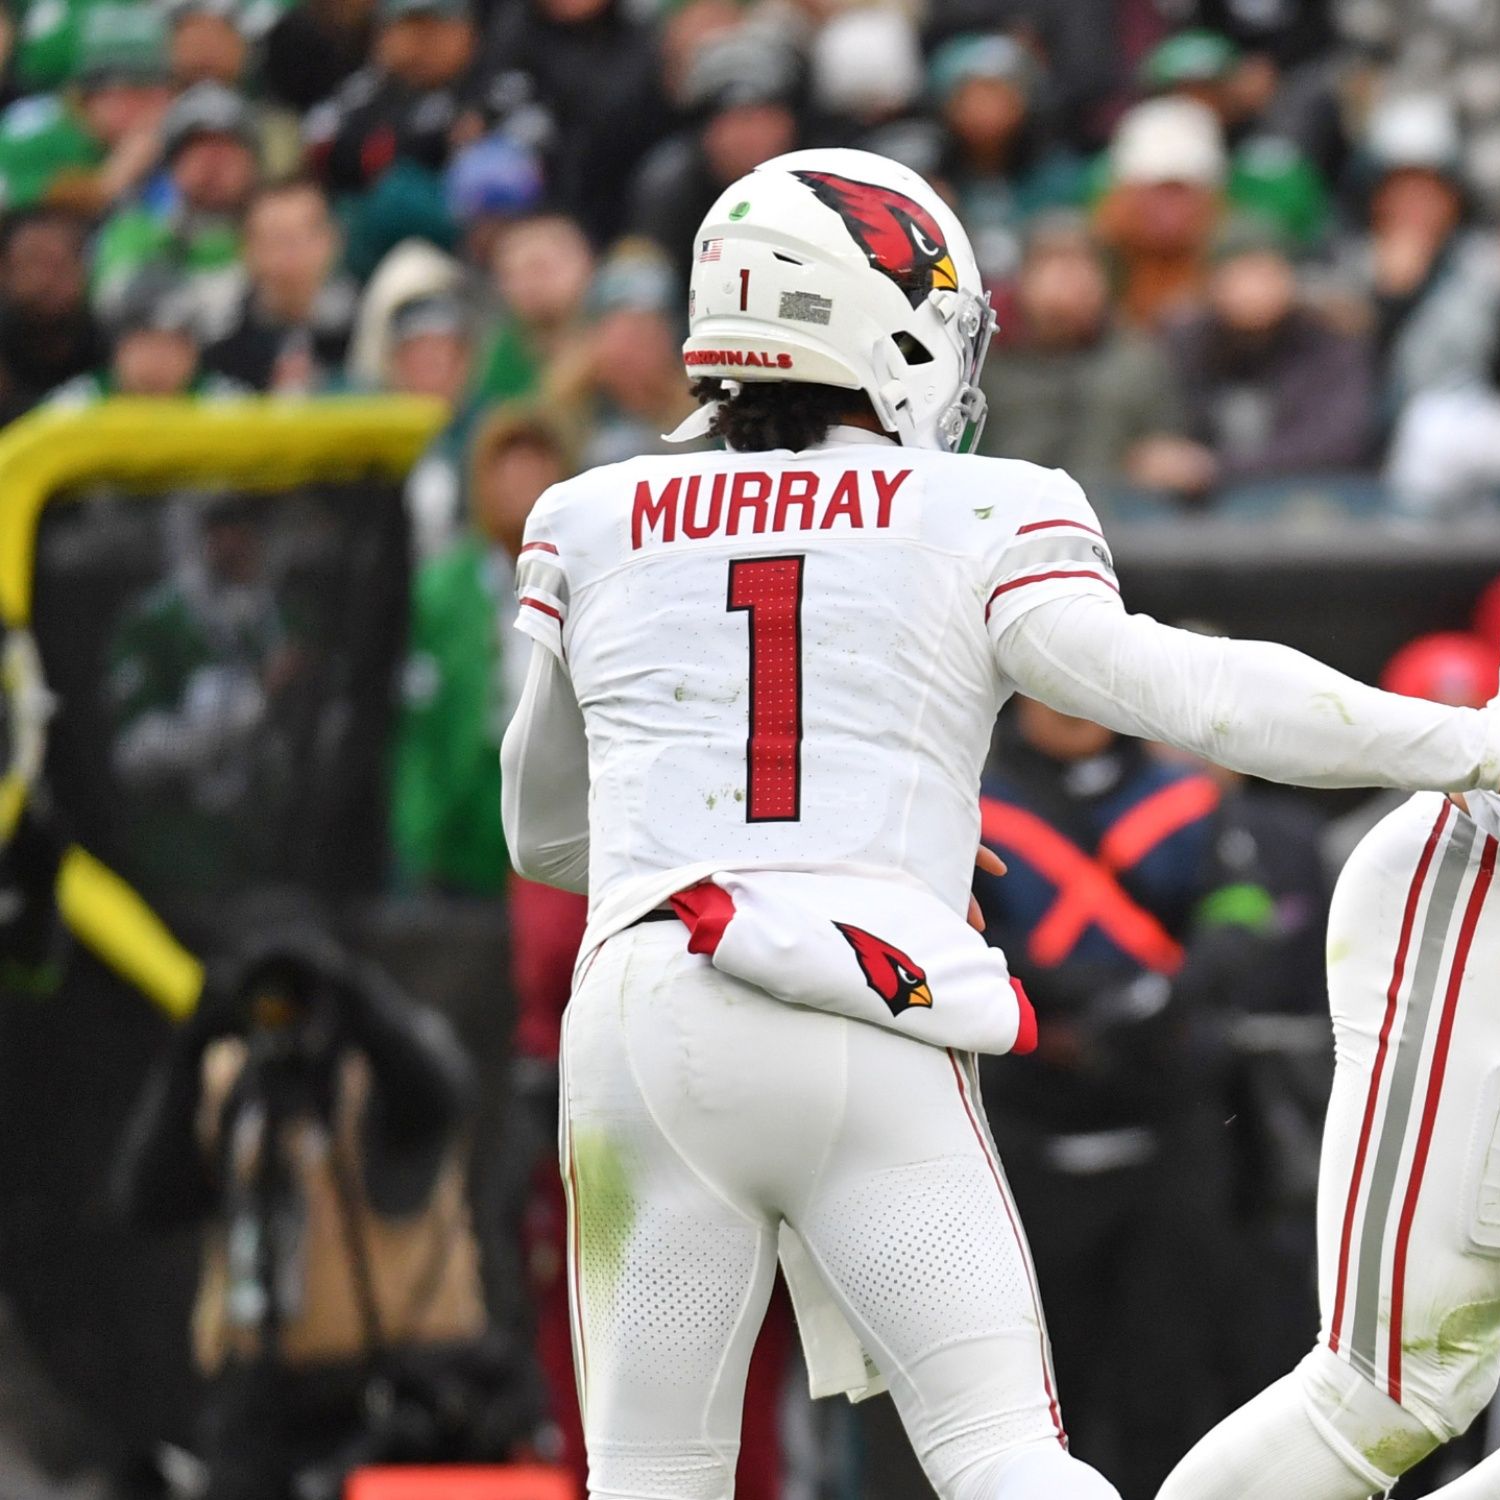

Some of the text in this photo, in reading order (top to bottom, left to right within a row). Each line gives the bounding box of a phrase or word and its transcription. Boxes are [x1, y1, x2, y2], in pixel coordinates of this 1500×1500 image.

[739, 269, 750, 312] 1
[631, 468, 913, 550] MURRAY
[725, 553, 806, 824] 1
